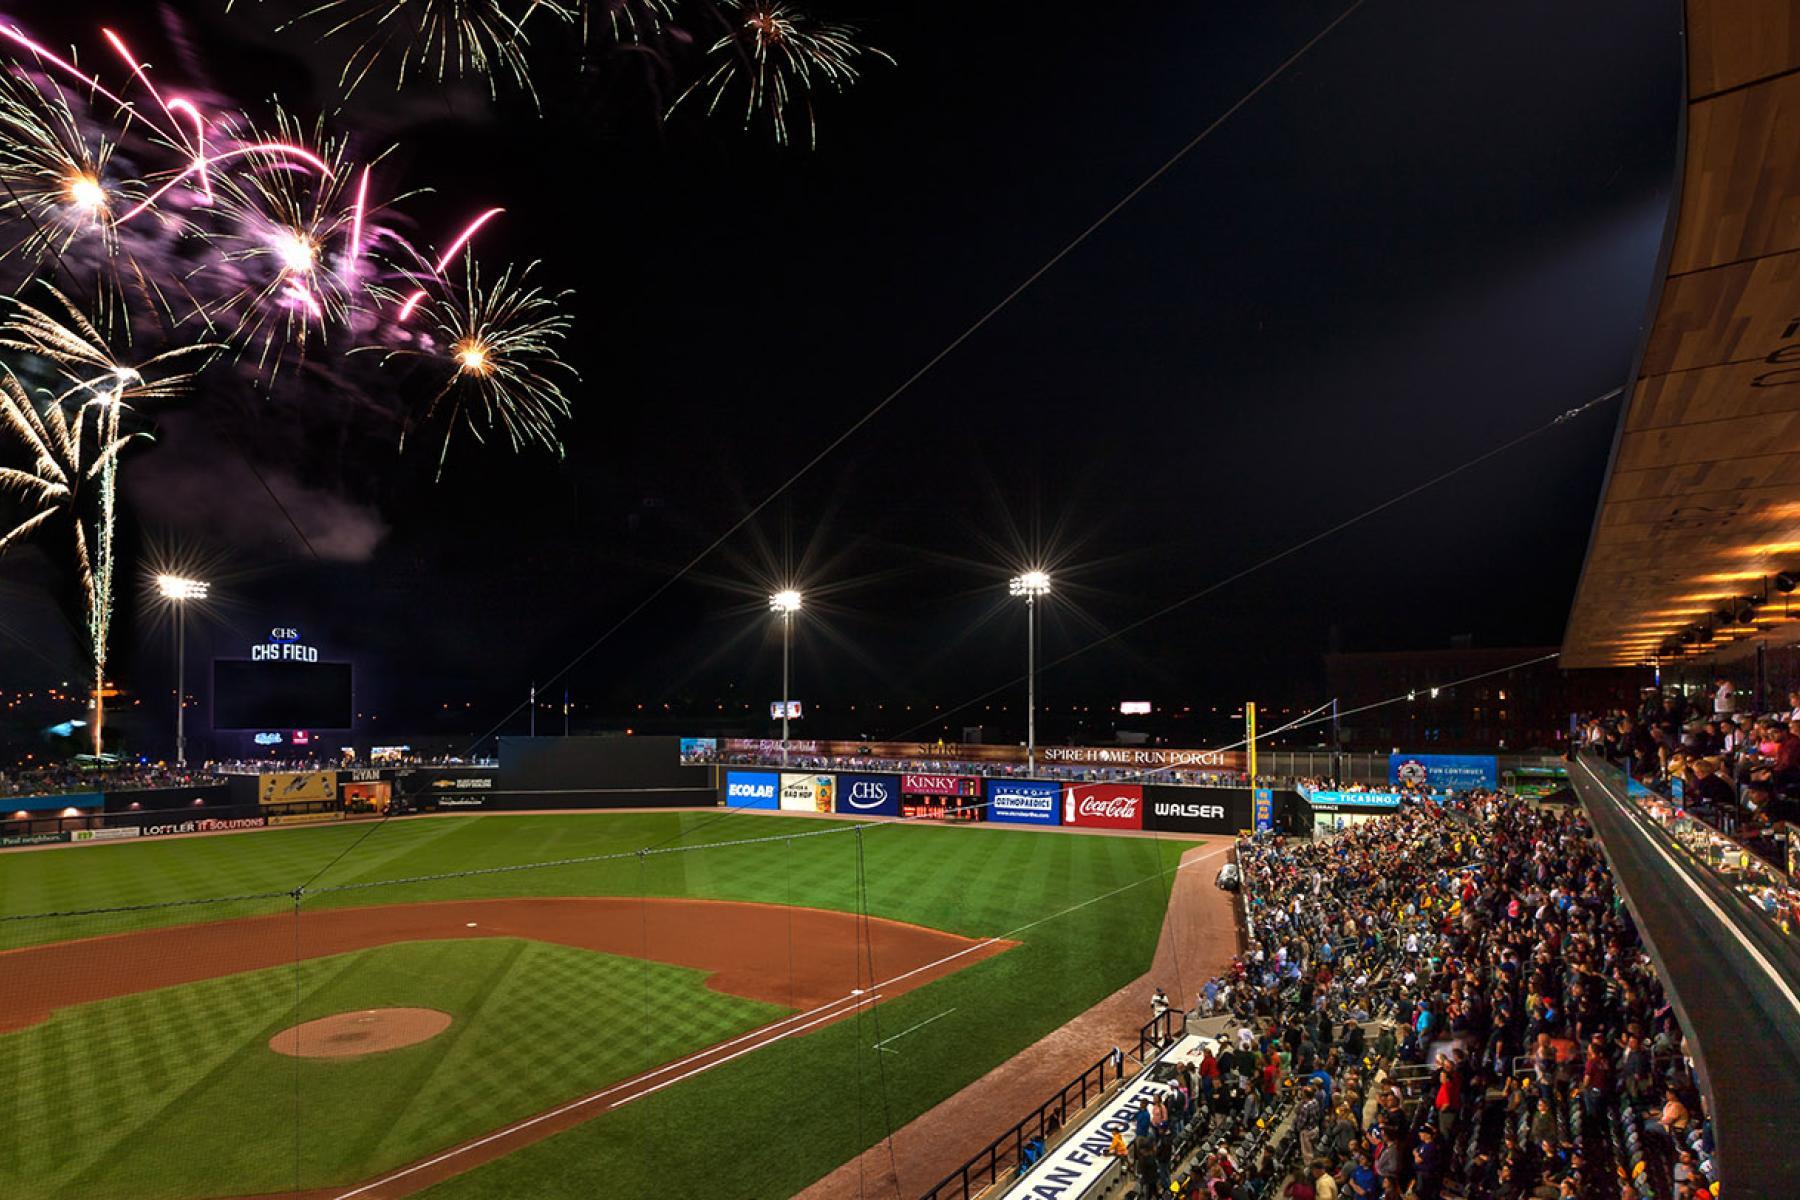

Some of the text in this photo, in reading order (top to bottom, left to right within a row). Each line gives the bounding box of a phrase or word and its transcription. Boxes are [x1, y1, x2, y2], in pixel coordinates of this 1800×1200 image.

[271, 627, 298, 638] CHS
[252, 643, 318, 662] CHS FIELD
[1044, 748, 1225, 766] SPIRE HOME RUN PORCH
[351, 769, 380, 780] RYAN
[905, 775, 957, 789] KINKY
[728, 783, 774, 798] ECOLAB
[852, 781, 885, 799] CHS
[1155, 802, 1225, 819] WALSER
[143, 823, 195, 836] LOFFLER
[209, 817, 265, 831] SOLUTIONS
[1022, 1166, 1082, 1200] AN
